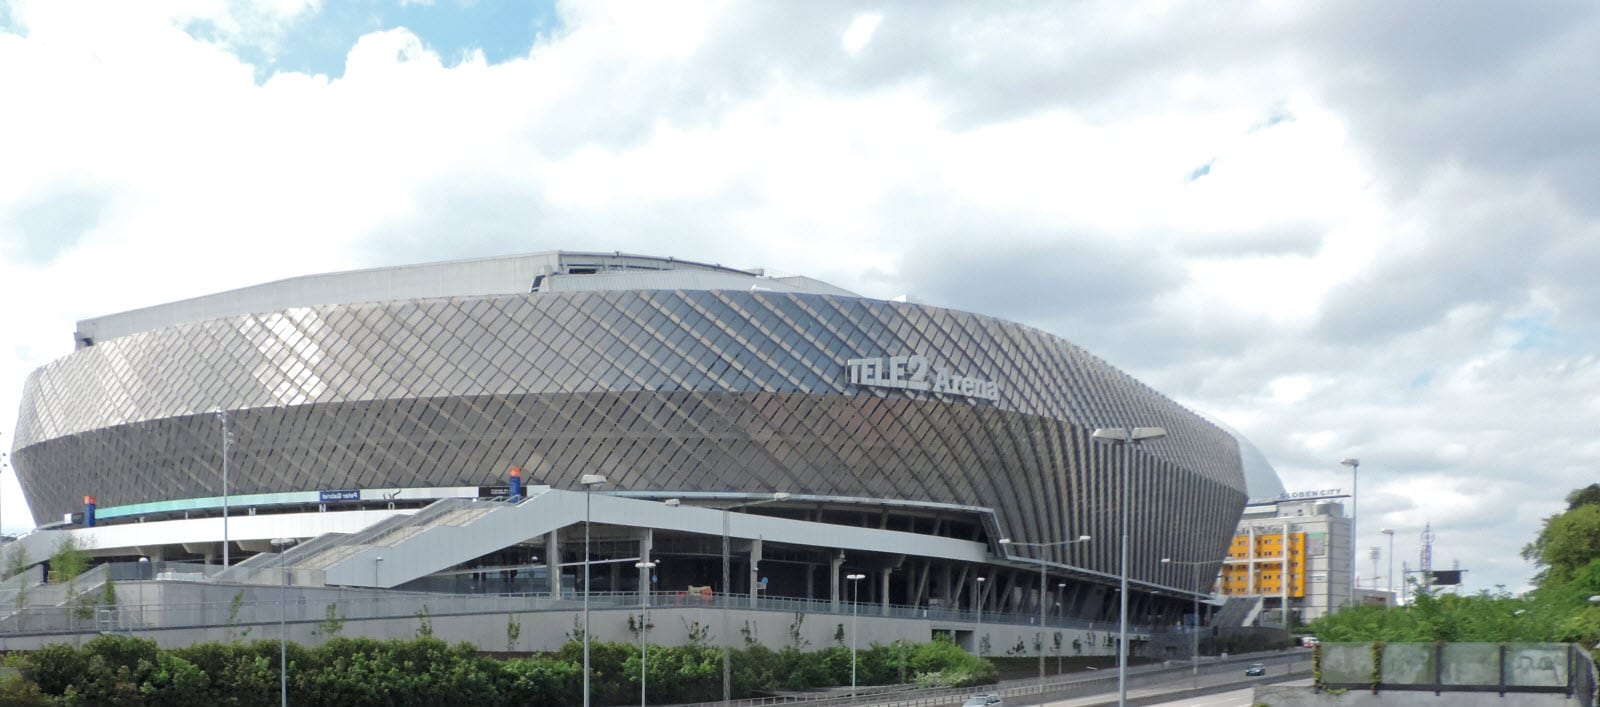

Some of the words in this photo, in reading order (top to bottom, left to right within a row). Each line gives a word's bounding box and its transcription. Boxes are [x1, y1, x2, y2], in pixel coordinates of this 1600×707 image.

[847, 354, 930, 391] TELE2
[933, 367, 1000, 401] Arena
[1320, 488, 1342, 496] CITY
